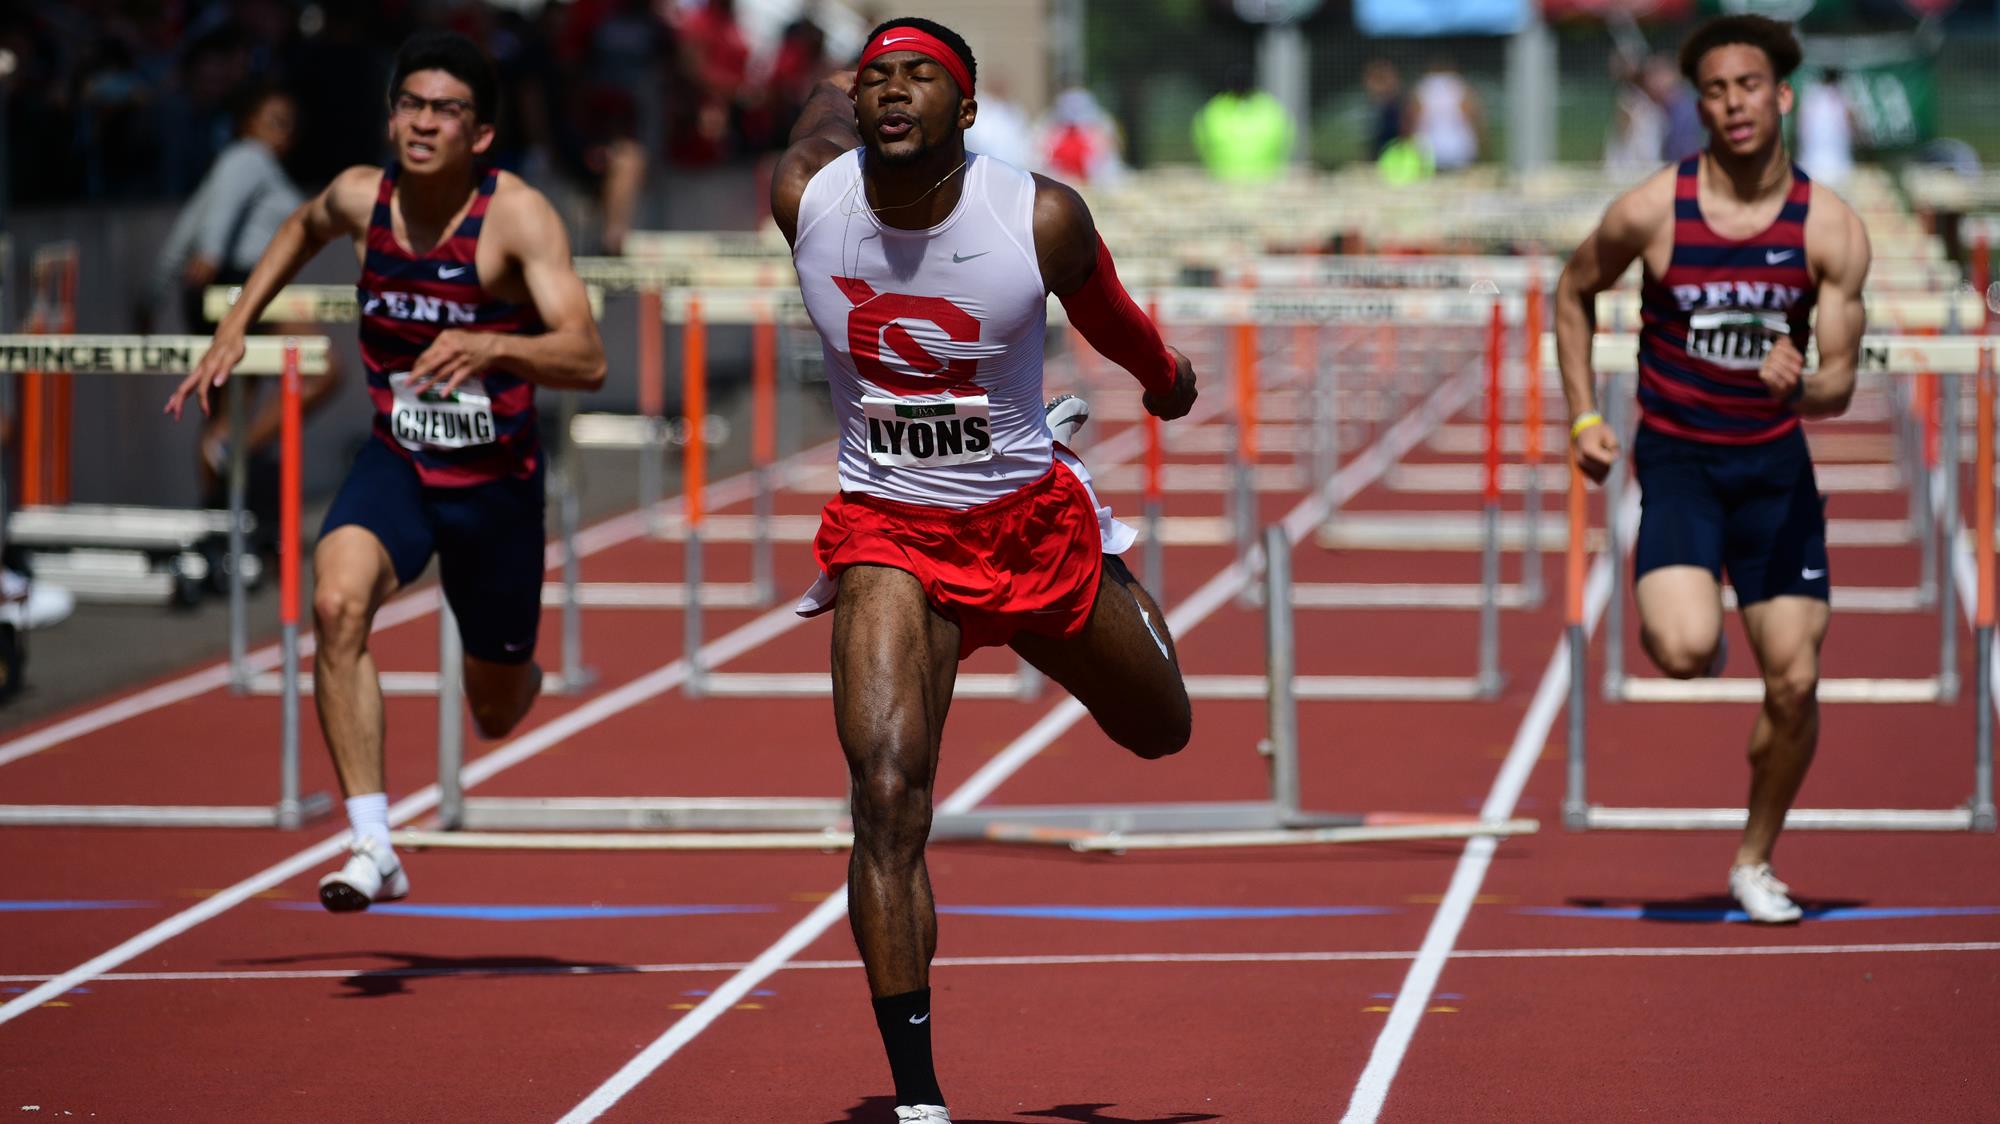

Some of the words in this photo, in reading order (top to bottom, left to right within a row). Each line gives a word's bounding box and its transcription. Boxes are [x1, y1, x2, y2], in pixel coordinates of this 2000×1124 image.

[1672, 281, 1801, 311] PENN
[397, 409, 490, 440] CHEUNG
[868, 416, 990, 459] LYONS
